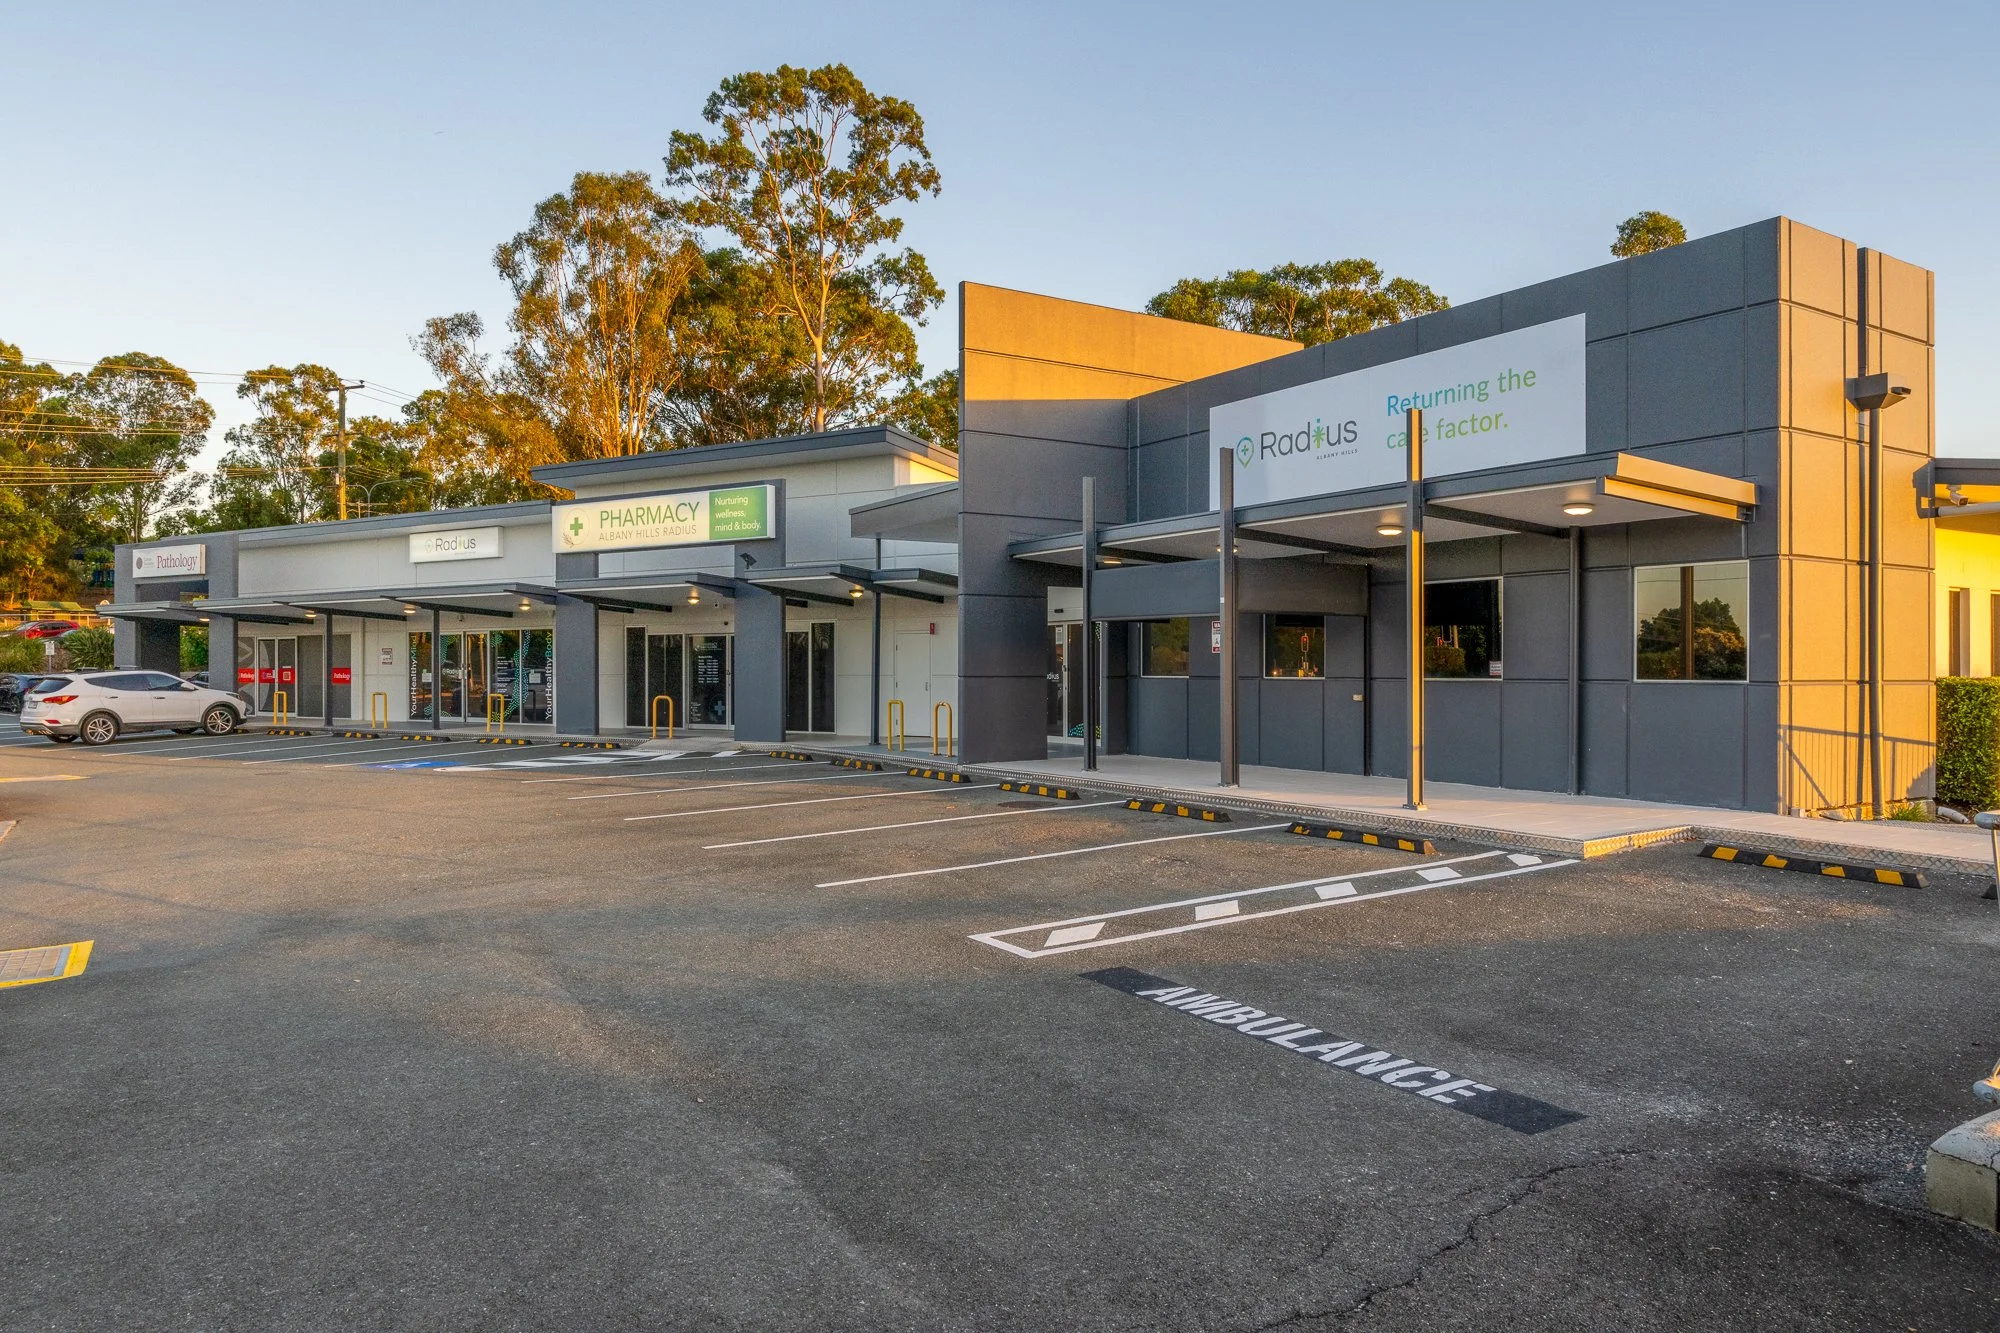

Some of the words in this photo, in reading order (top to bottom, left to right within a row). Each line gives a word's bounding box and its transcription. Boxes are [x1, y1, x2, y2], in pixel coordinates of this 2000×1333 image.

[1387, 380, 1490, 417] Returning
[1497, 368, 1537, 393] the
[1260, 418, 1358, 460] Radius
[1386, 427, 1429, 449] cae
[1436, 412, 1508, 441] factor.
[1316, 452, 1339, 460] ALBANY
[1341, 448, 1358, 456] HILLS
[714, 495, 749, 506] Nurturing
[600, 501, 700, 529] PHARMACY
[715, 510, 746, 519] wellness,
[599, 530, 634, 542] ALBANY
[635, 527, 660, 538] HILLS
[663, 525, 697, 536] RADIUS
[714, 522, 733, 532] mind
[734, 522, 741, 531] &
[741, 520, 762, 532] body.
[435, 536, 477, 551] Radius
[156, 553, 198, 571] Pathology
[545, 632, 553, 720] YourHealthyBody
[1135, 986, 1498, 1104] AMBULANCE
